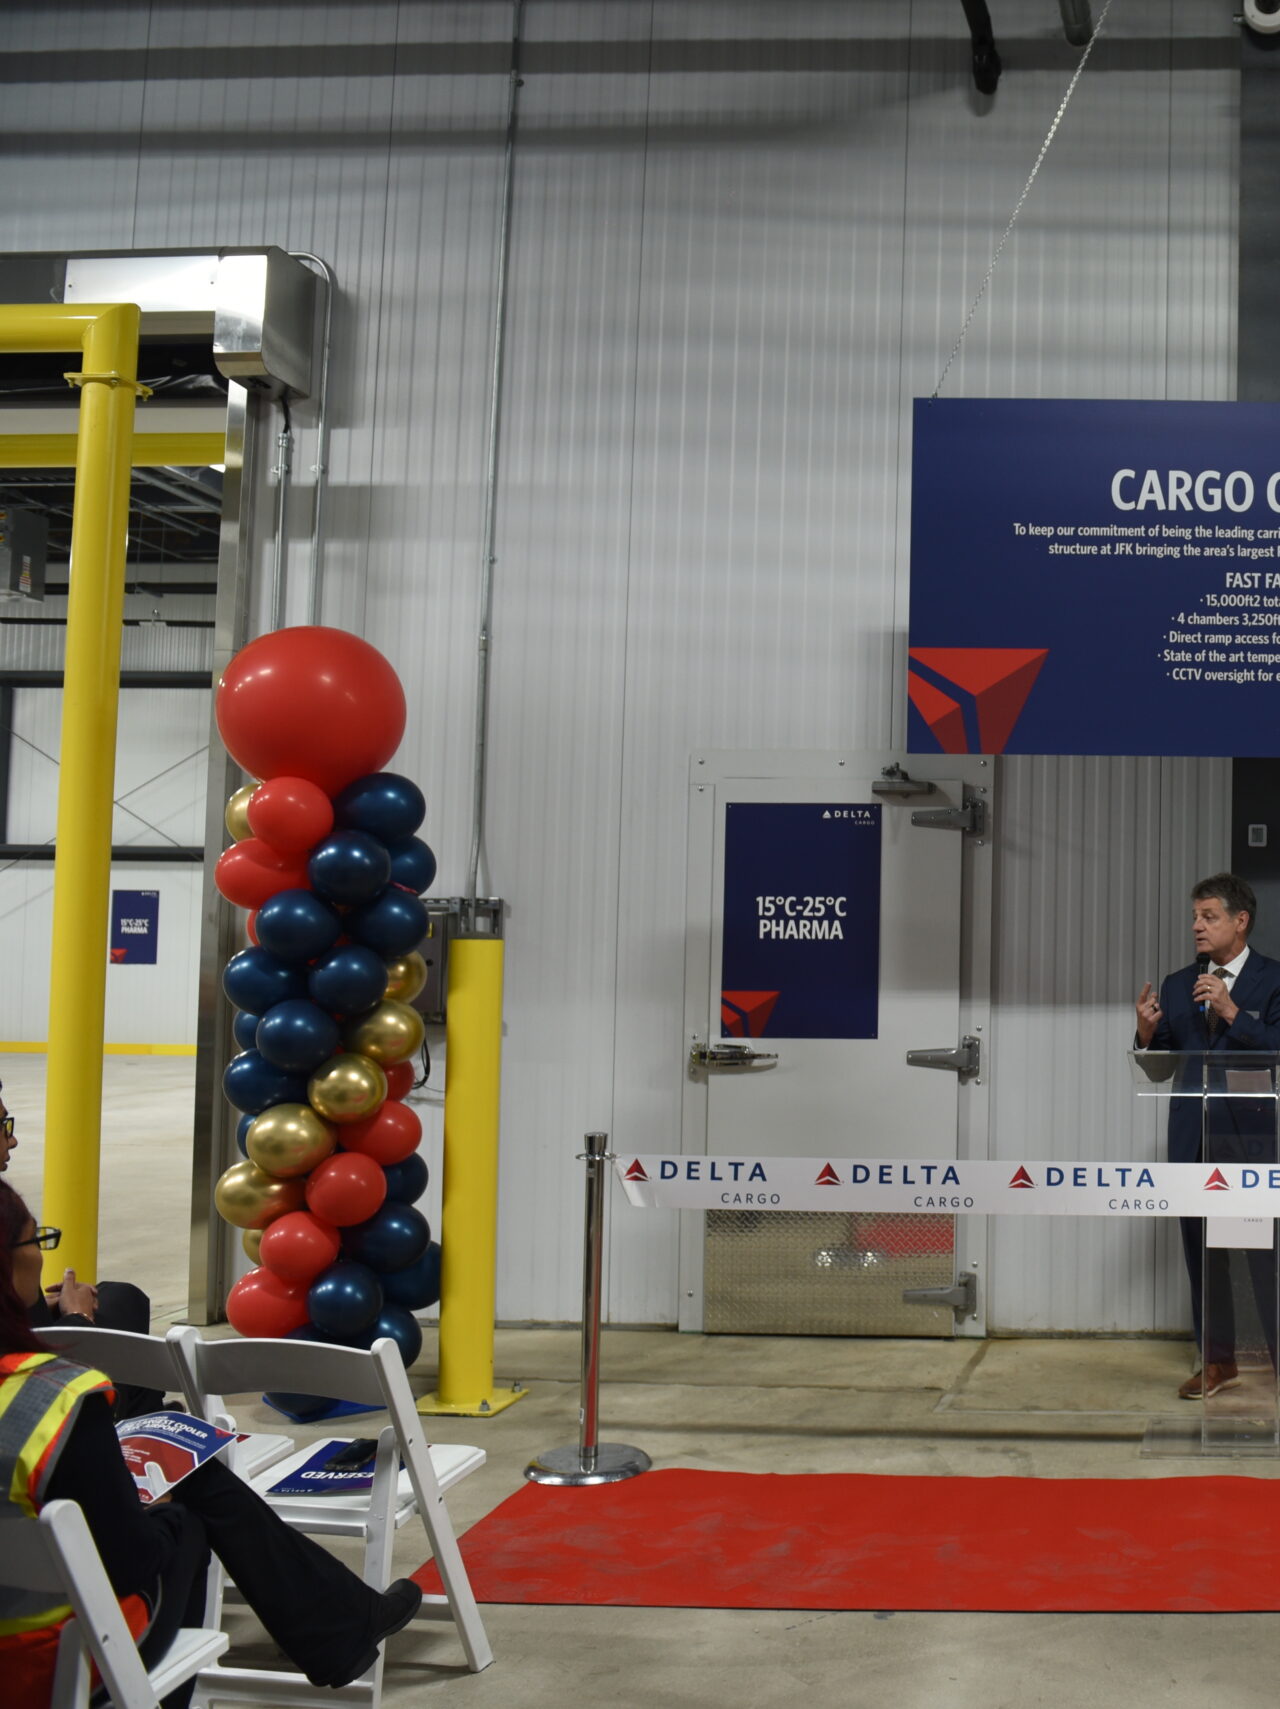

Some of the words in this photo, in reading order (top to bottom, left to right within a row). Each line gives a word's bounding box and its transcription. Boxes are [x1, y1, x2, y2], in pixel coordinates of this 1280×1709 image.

[1112, 468, 1254, 512] CARGO
[1014, 523, 1026, 535] To
[1029, 523, 1054, 538] keep
[1057, 526, 1076, 536] our
[1078, 524, 1146, 537] commitment
[1148, 524, 1160, 537] of
[1162, 524, 1192, 540] being
[1194, 525, 1213, 538] the
[1215, 526, 1255, 541] leading
[1049, 543, 1098, 555] structure
[1100, 544, 1112, 555] at
[1114, 543, 1133, 555] JFK
[1136, 543, 1181, 558] bringing
[1183, 544, 1201, 556] the
[1238, 544, 1274, 560] largest
[1226, 572, 1262, 588] FAST
[1206, 594, 1260, 607] 15,000ft2
[1177, 612, 1185, 624] 4
[1188, 612, 1240, 625] chambers
[1169, 631, 1202, 643] Direct
[1205, 634, 1232, 646] ramp
[1235, 635, 1270, 644] access
[1164, 649, 1192, 662] State
[1194, 650, 1206, 662] of
[1208, 650, 1226, 662] the
[1229, 651, 1244, 662] art
[1172, 668, 1202, 680] CCTV
[1204, 669, 1255, 684] oversight
[1258, 669, 1274, 682] for
[834, 810, 870, 818] DELTA
[756, 896, 846, 917] 15°C-25°C
[760, 920, 843, 940] PHARMA
[660, 1160, 768, 1182] DELTA
[852, 1164, 960, 1186] DELTA
[1046, 1167, 1155, 1188] DELTA
[720, 1192, 781, 1206] CARGO
[914, 1196, 974, 1208] CARGO
[1108, 1199, 1169, 1210] CARGO
[174, 1422, 208, 1439] COOLER
[300, 1471, 375, 1479] ESERVED
